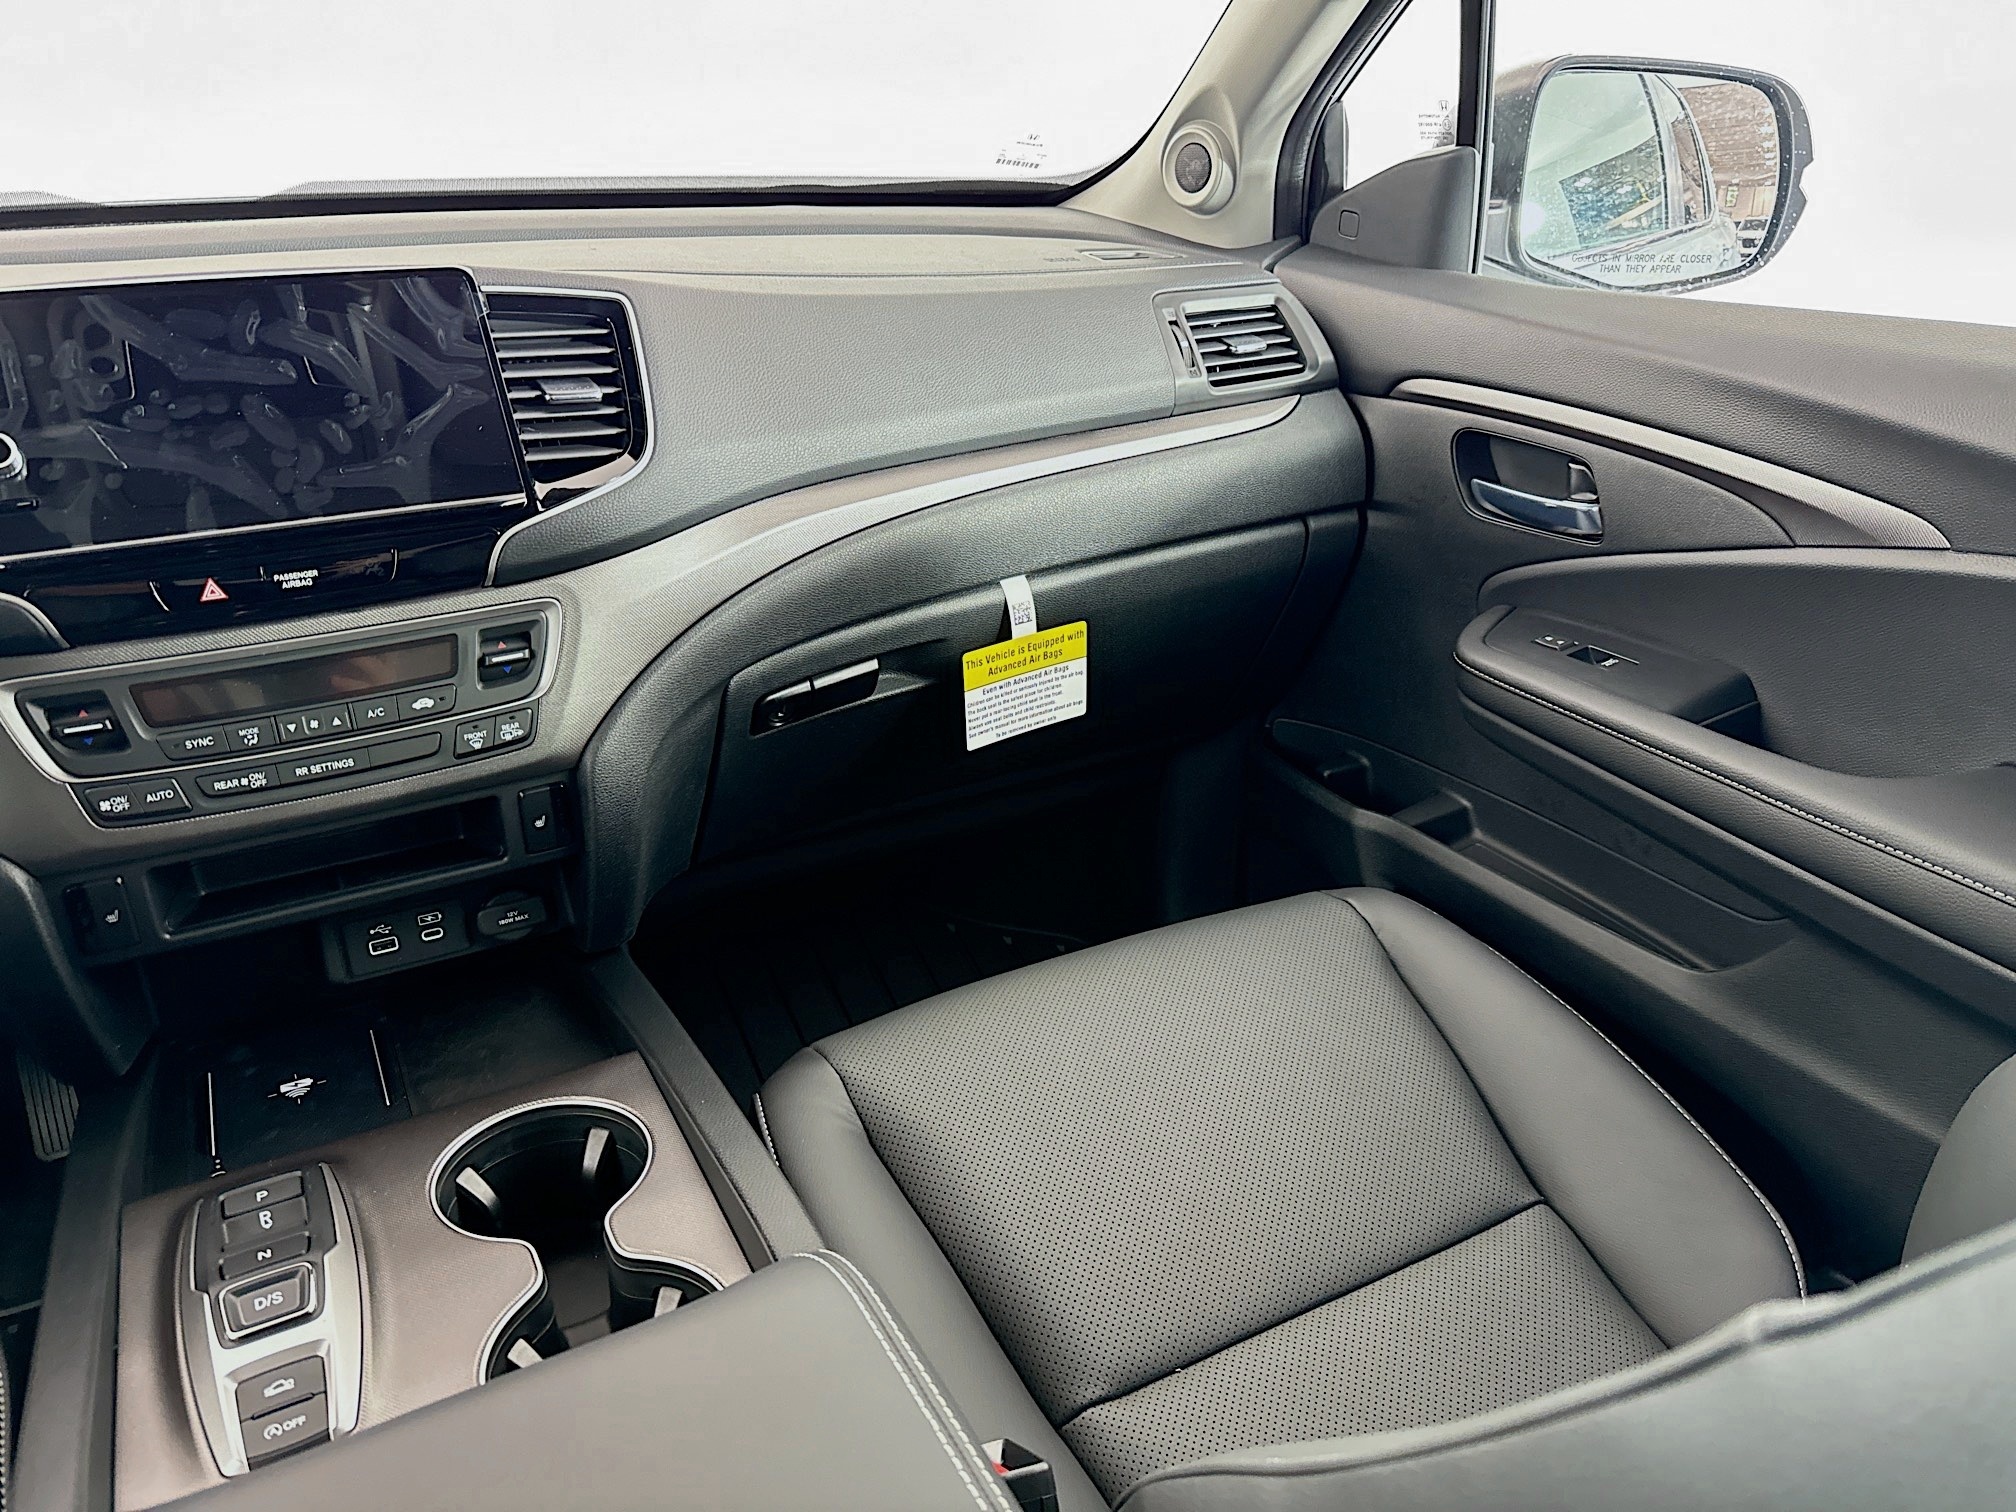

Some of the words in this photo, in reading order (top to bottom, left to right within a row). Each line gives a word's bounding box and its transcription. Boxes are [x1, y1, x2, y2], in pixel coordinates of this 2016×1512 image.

[1611, 254, 1620, 262] IN
[1625, 253, 1656, 263] MIRROR
[1660, 254, 1675, 263] ARE
[1680, 254, 1712, 264] CLOSER
[1600, 264, 1621, 273] THAN
[1626, 264, 1646, 273] THEY
[1649, 264, 1682, 273] APPEAR
[273, 569, 318, 582] PASSENGER
[282, 577, 313, 589] AIRBAG
[966, 658, 983, 670] This
[985, 648, 1016, 664] Vehicle
[1018, 645, 1025, 655] is
[1027, 633, 1065, 652] Equipped
[1067, 629, 1085, 641] with
[988, 658, 1027, 677] Advanced
[1029, 654, 1041, 665] Air
[1043, 648, 1063, 660] Bags
[982, 685, 998, 696] Even
[999, 681, 1012, 690] with
[1013, 671, 1043, 686] Advanced
[1043, 669, 1053, 677] Air
[1053, 665, 1069, 675] Bags
[367, 708, 385, 718] A/C
[239, 727, 260, 737] MODE
[501, 722, 520, 731] REAR
[463, 730, 488, 741] FRONT
[185, 736, 215, 750] SYNC
[295, 767, 309, 777] RR
[310, 758, 355, 774] SETTINGS
[213, 778, 240, 791] REAR
[249, 771, 266, 781] ON/
[250, 778, 268, 789] OFF
[110, 795, 129, 806] ON/
[146, 789, 174, 802] AUTO
[113, 802, 131, 813] OFF
[507, 910, 518, 918] 12V
[515, 913, 530, 921] MAX
[256, 1190, 269, 1202] P
[257, 1249, 272, 1260] N
[254, 1291, 283, 1311] D/S
[283, 1415, 306, 1431] OFF
